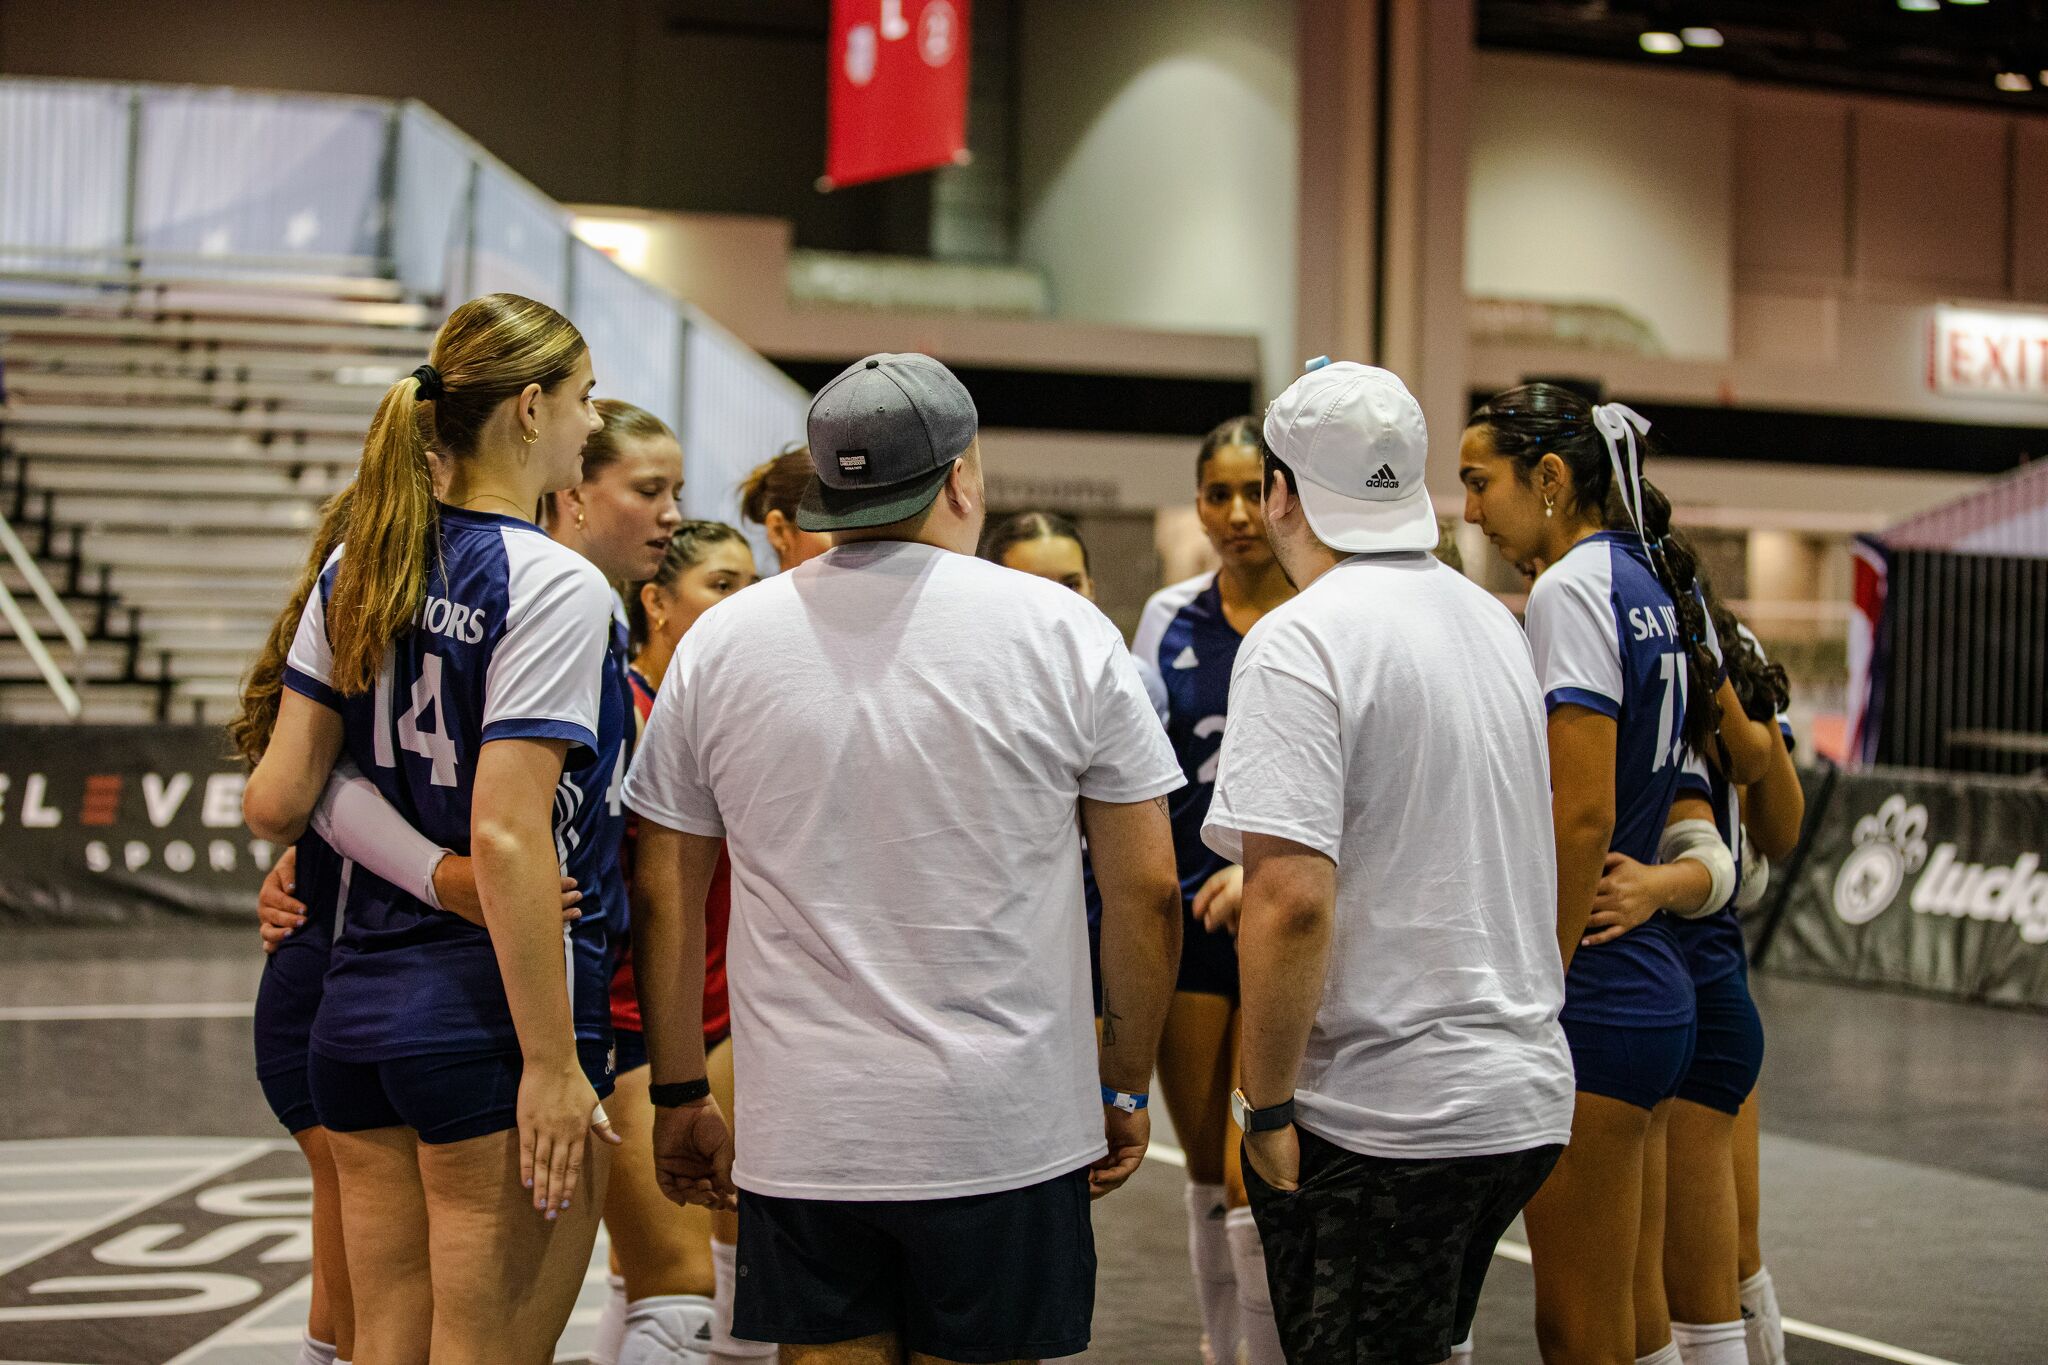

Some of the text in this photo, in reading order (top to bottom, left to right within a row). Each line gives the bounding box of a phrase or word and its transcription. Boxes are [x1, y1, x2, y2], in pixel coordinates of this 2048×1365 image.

[1947, 331, 2048, 386] EXIT
[1365, 478, 1400, 488] adidas
[412, 595, 487, 645] IORS
[0, 772, 247, 828] LEVE
[84, 839, 274, 873] SPORT
